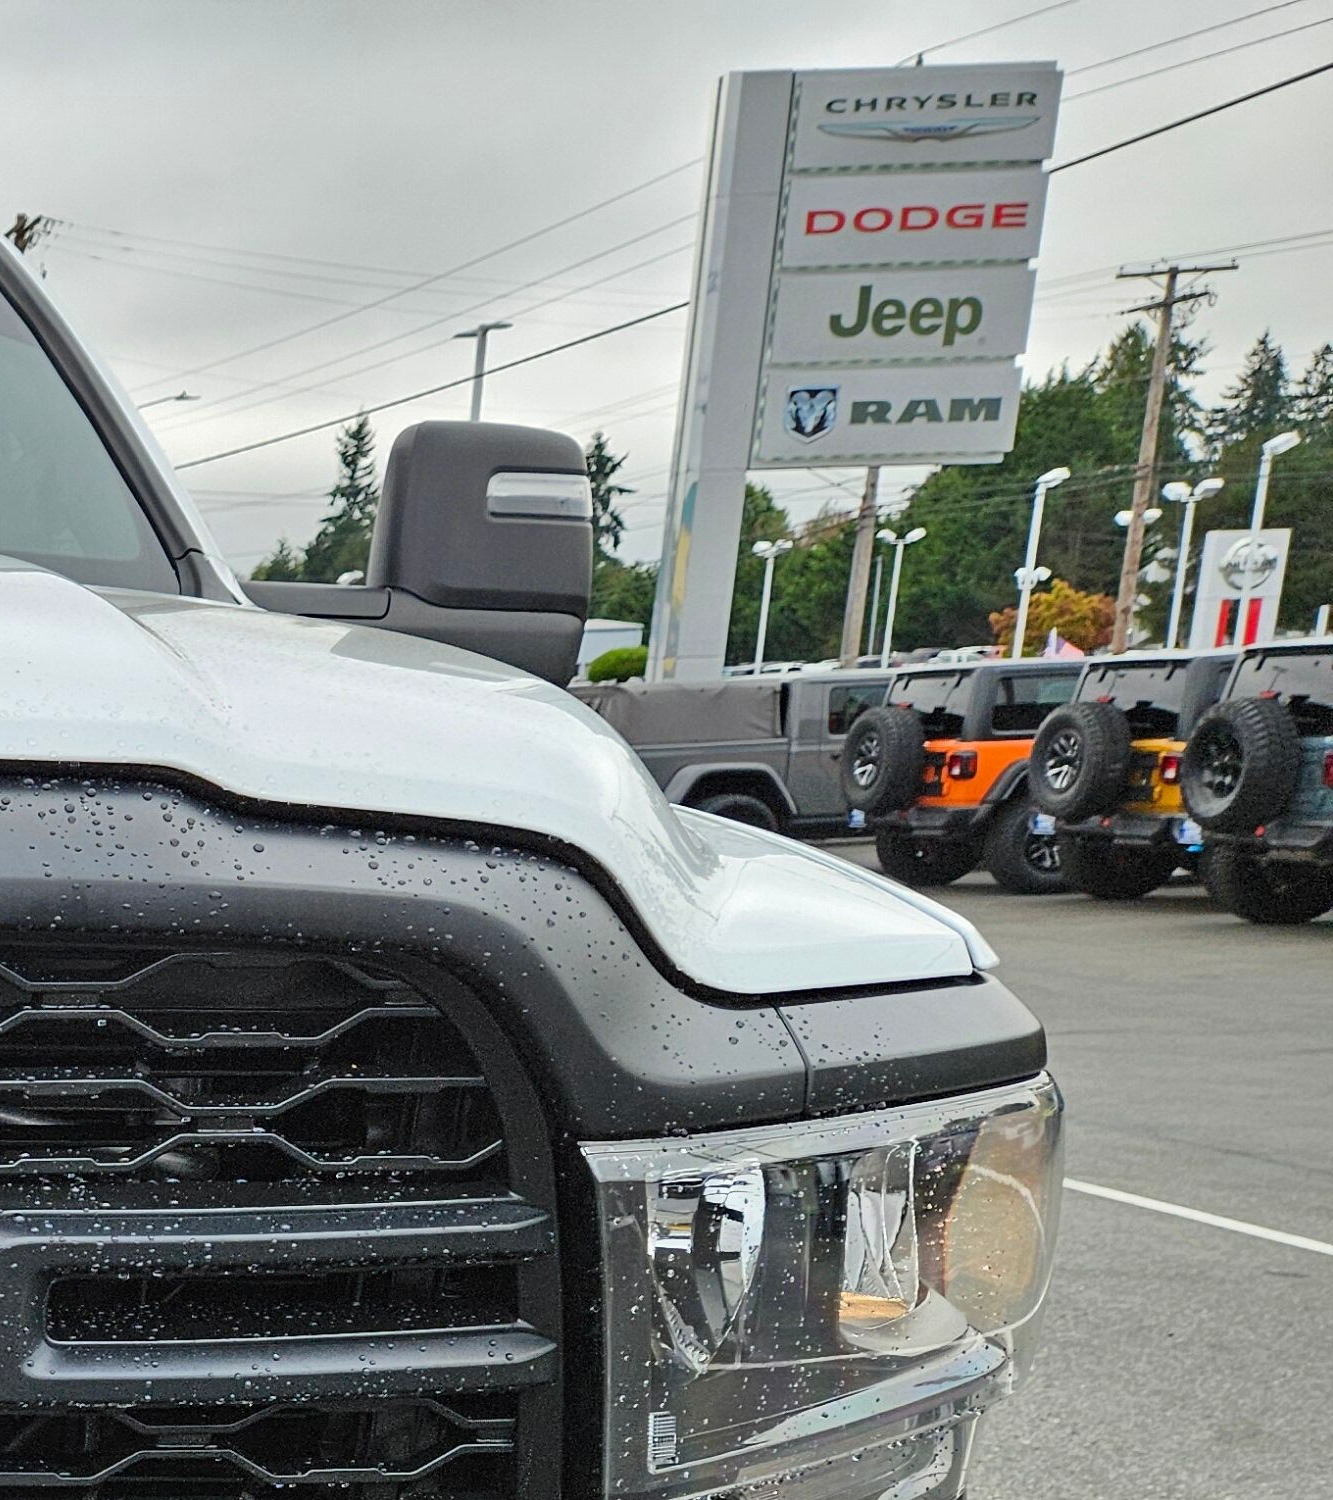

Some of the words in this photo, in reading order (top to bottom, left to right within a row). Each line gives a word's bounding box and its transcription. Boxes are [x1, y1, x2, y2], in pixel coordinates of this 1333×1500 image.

[825, 91, 1038, 114] CHRYSLER
[804, 202, 1029, 236] DODGE
[828, 284, 983, 347] Jeep
[848, 396, 1002, 425] RAM
